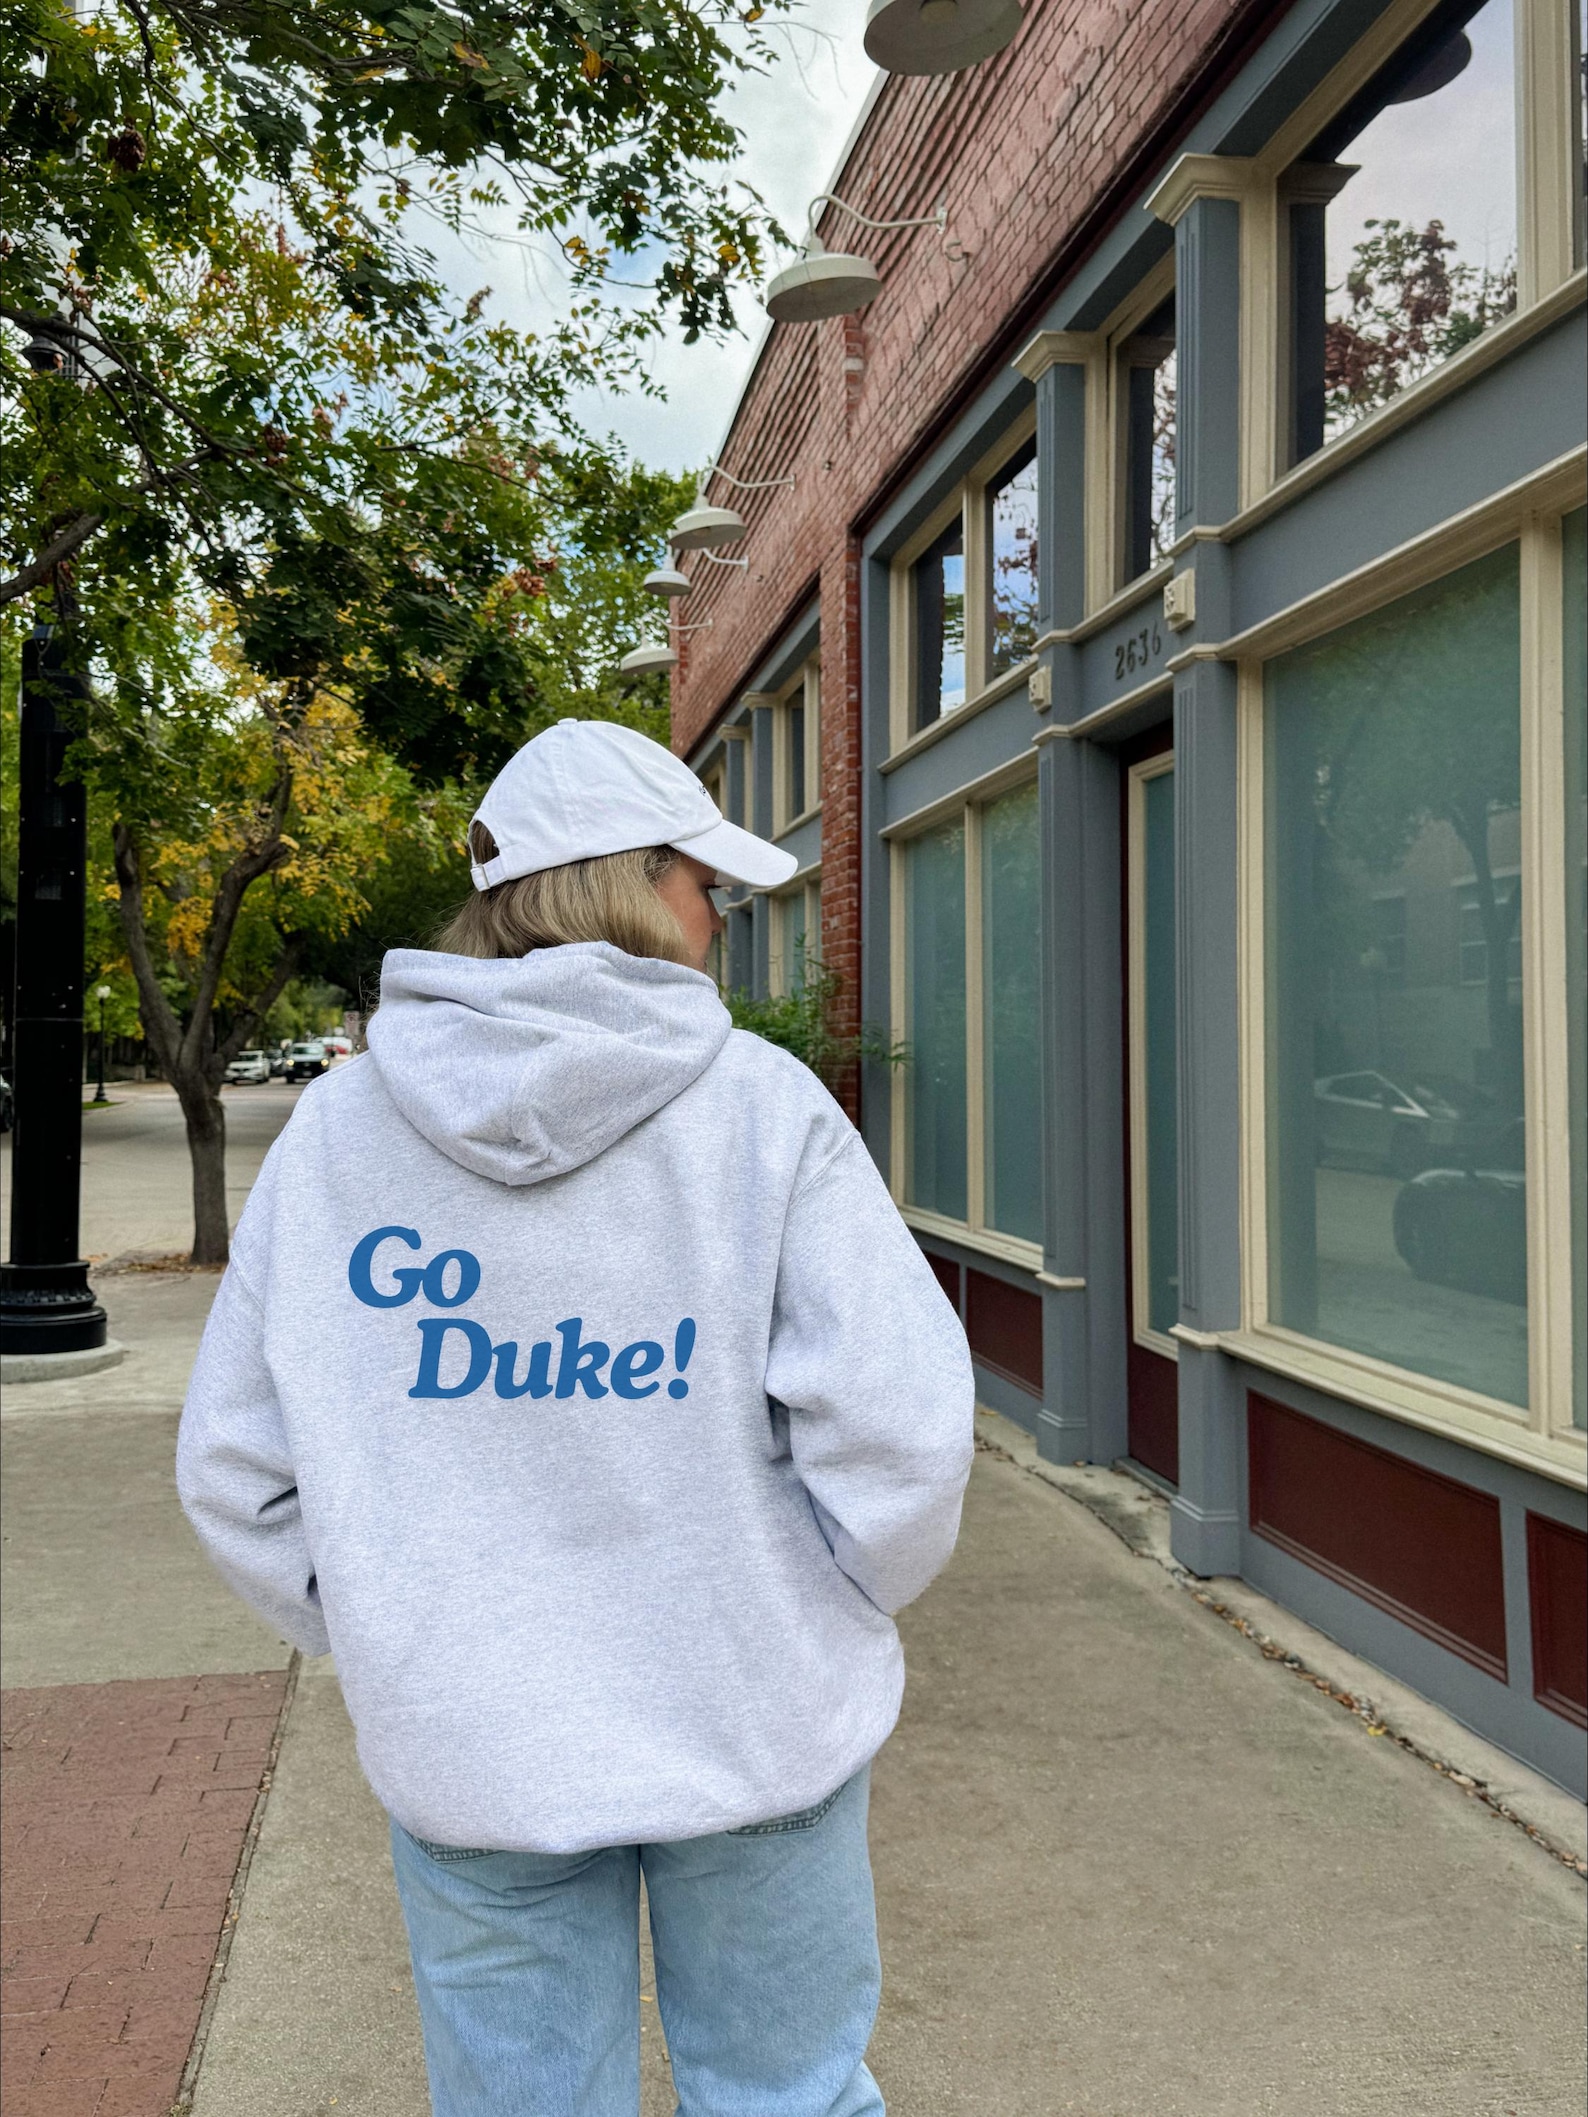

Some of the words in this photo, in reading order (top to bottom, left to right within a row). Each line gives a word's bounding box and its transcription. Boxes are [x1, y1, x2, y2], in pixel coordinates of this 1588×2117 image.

[1115, 621, 1162, 681] 2636
[348, 1225, 481, 1308] Go
[407, 1317, 697, 1400] Duke!
